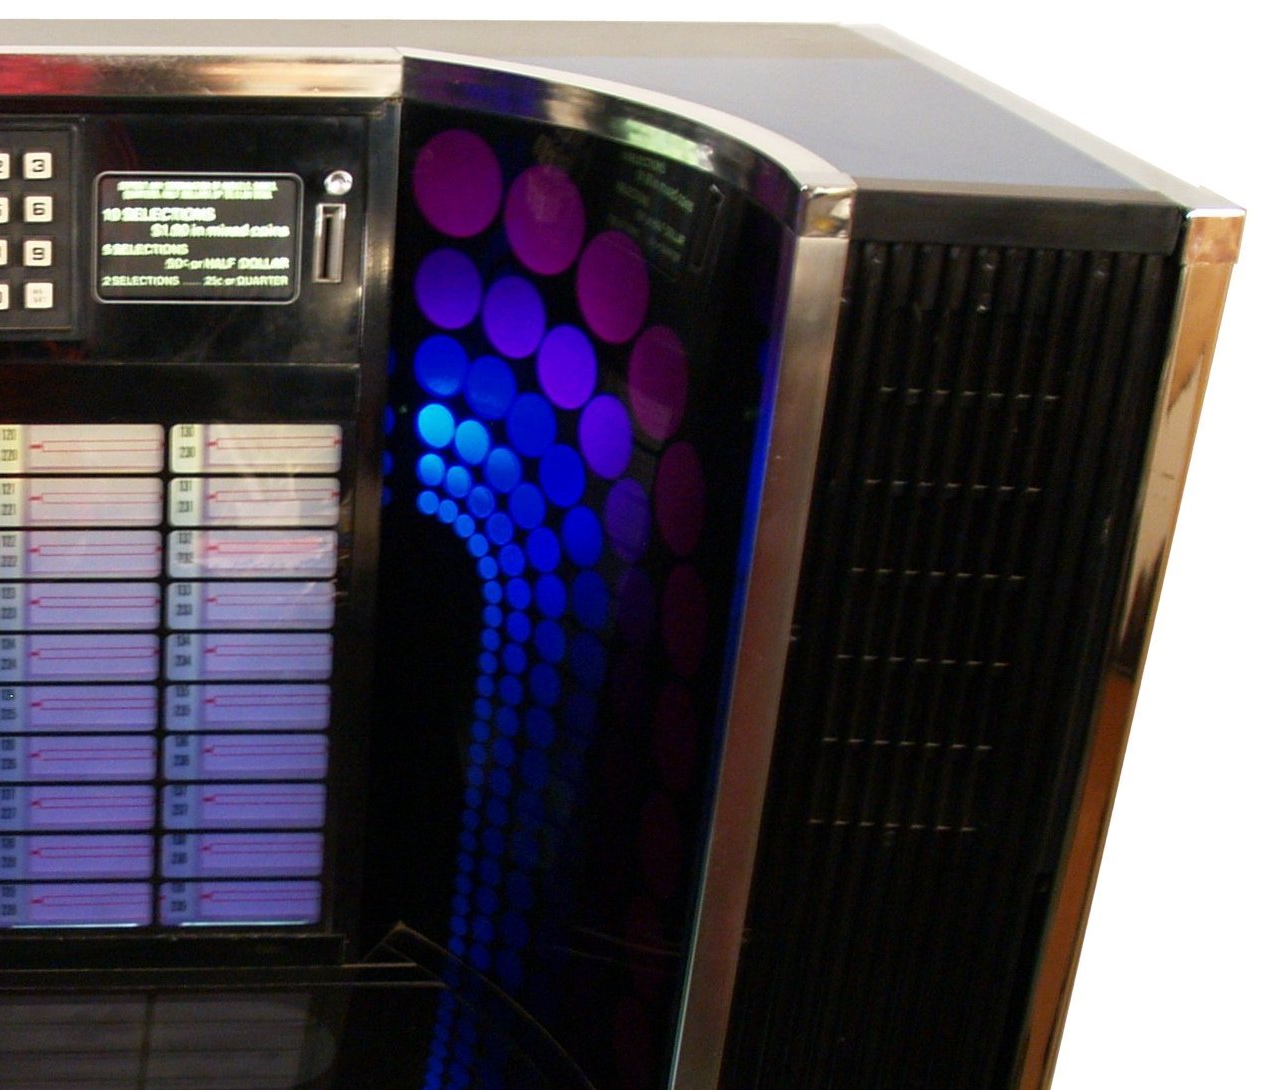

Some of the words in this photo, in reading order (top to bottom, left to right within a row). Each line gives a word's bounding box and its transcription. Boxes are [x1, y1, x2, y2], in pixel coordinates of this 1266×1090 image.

[32, 158, 46, 173] 3
[32, 202, 46, 216] 6
[121, 207, 217, 222] SELECTIONS
[32, 247, 46, 261] 9
[112, 243, 190, 256] SELECTIONS
[203, 257, 236, 270] HALF
[237, 257, 290, 270] DOLLAR
[112, 276, 180, 287] SELECTIONS
[236, 276, 289, 287] QUARTER
